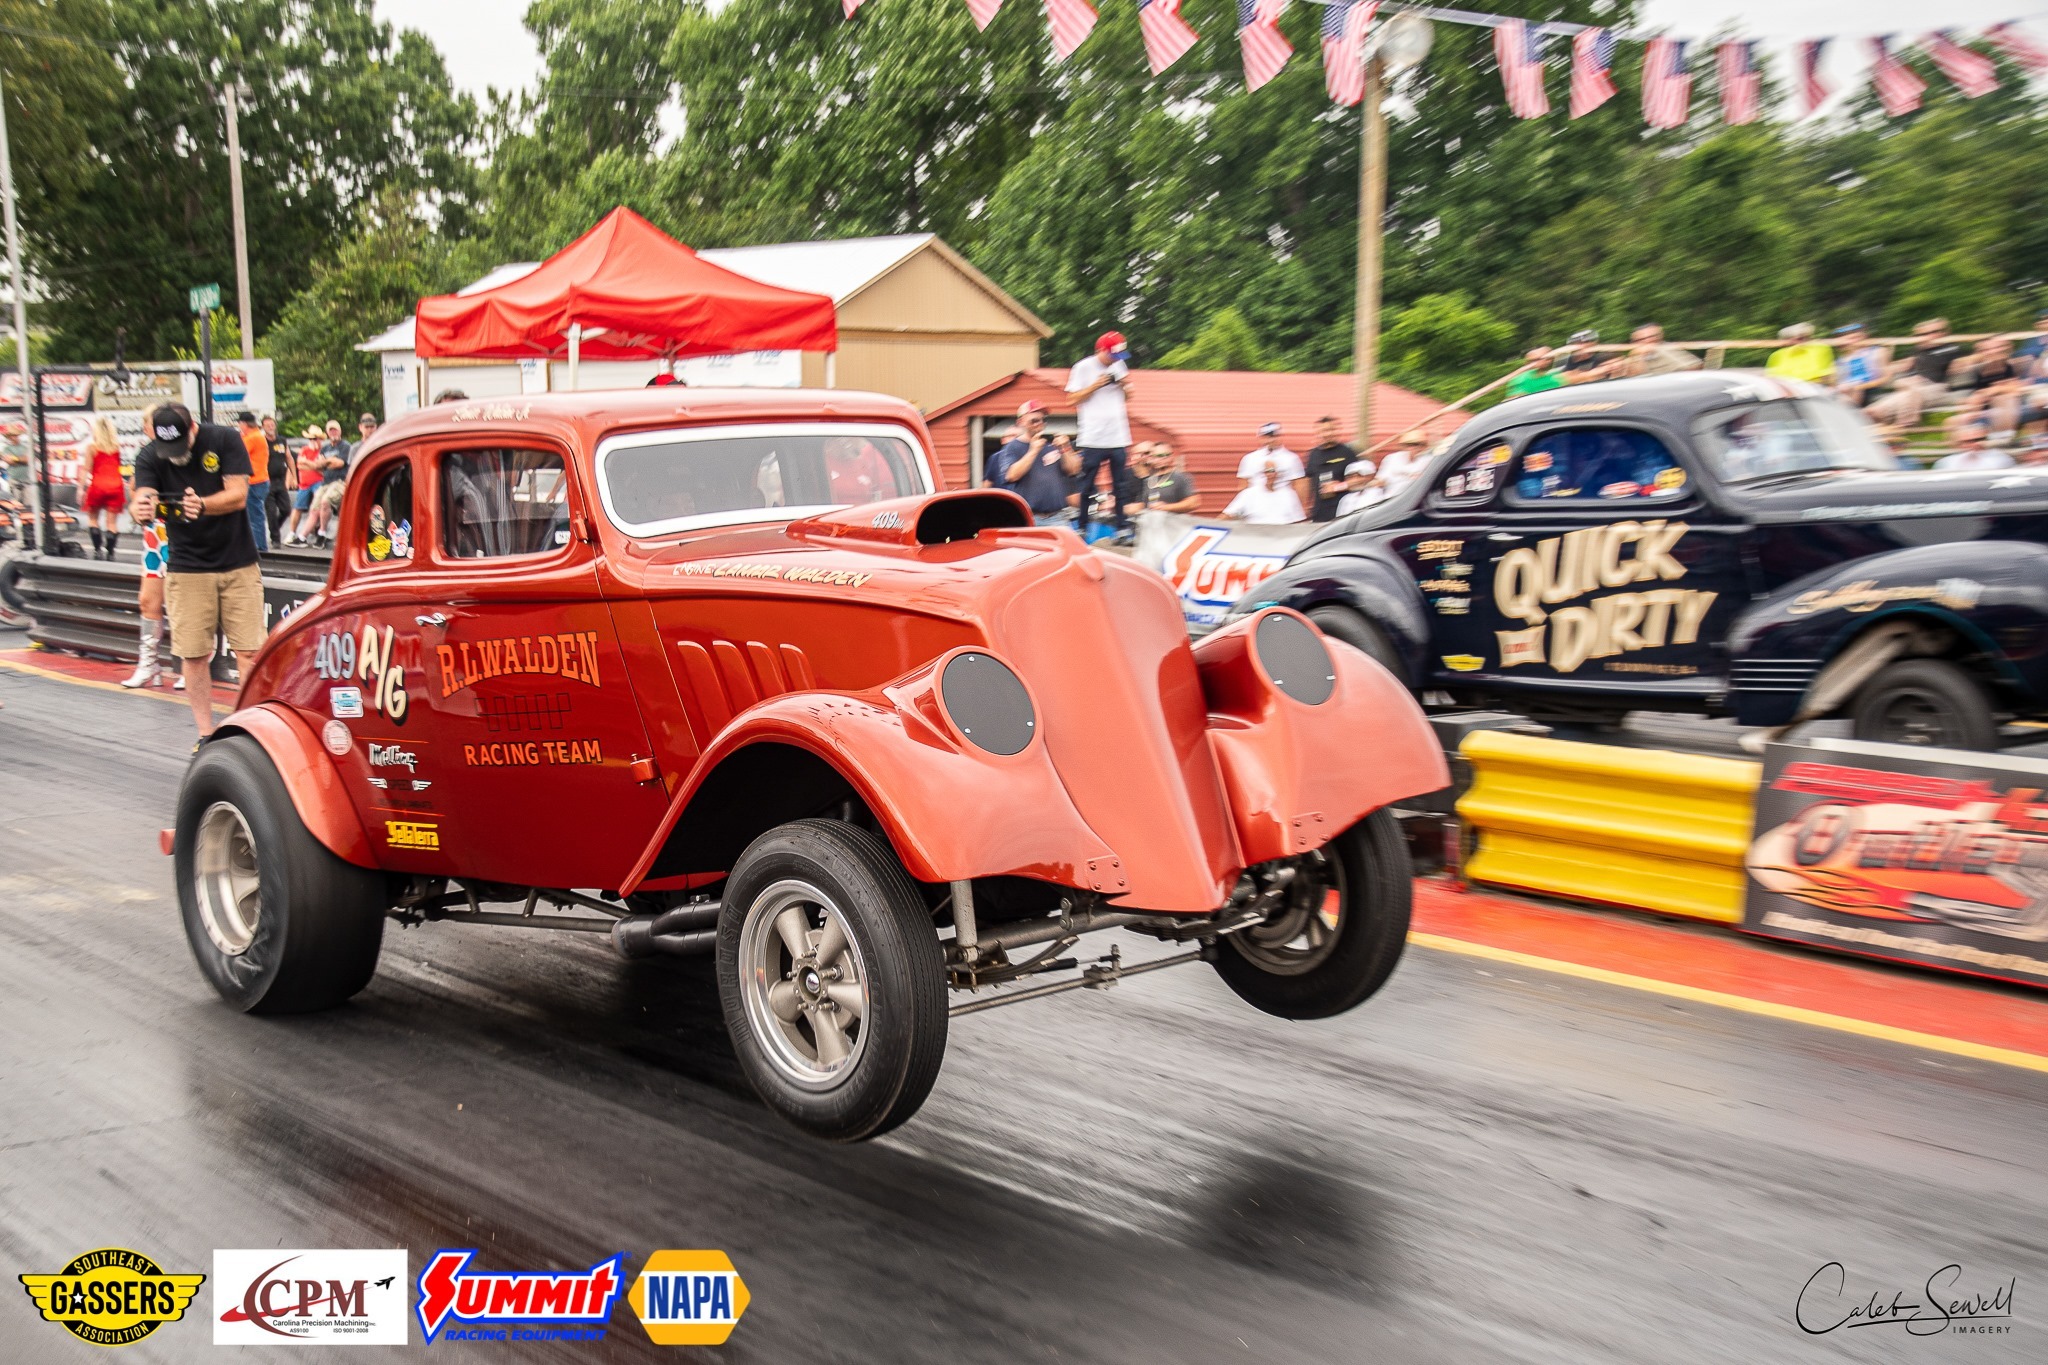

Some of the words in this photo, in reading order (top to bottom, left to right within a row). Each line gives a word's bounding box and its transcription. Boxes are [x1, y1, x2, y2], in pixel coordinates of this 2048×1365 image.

[872, 511, 899, 530] 409
[712, 563, 783, 579] LAMAR
[783, 566, 873, 588] WALDEN
[1493, 519, 1691, 626] QUICK
[1549, 588, 1719, 673] DIRTY
[314, 631, 356, 679] 409
[358, 624, 408, 719] A/G
[464, 742, 540, 766] RACING
[542, 740, 603, 764] TEAM
